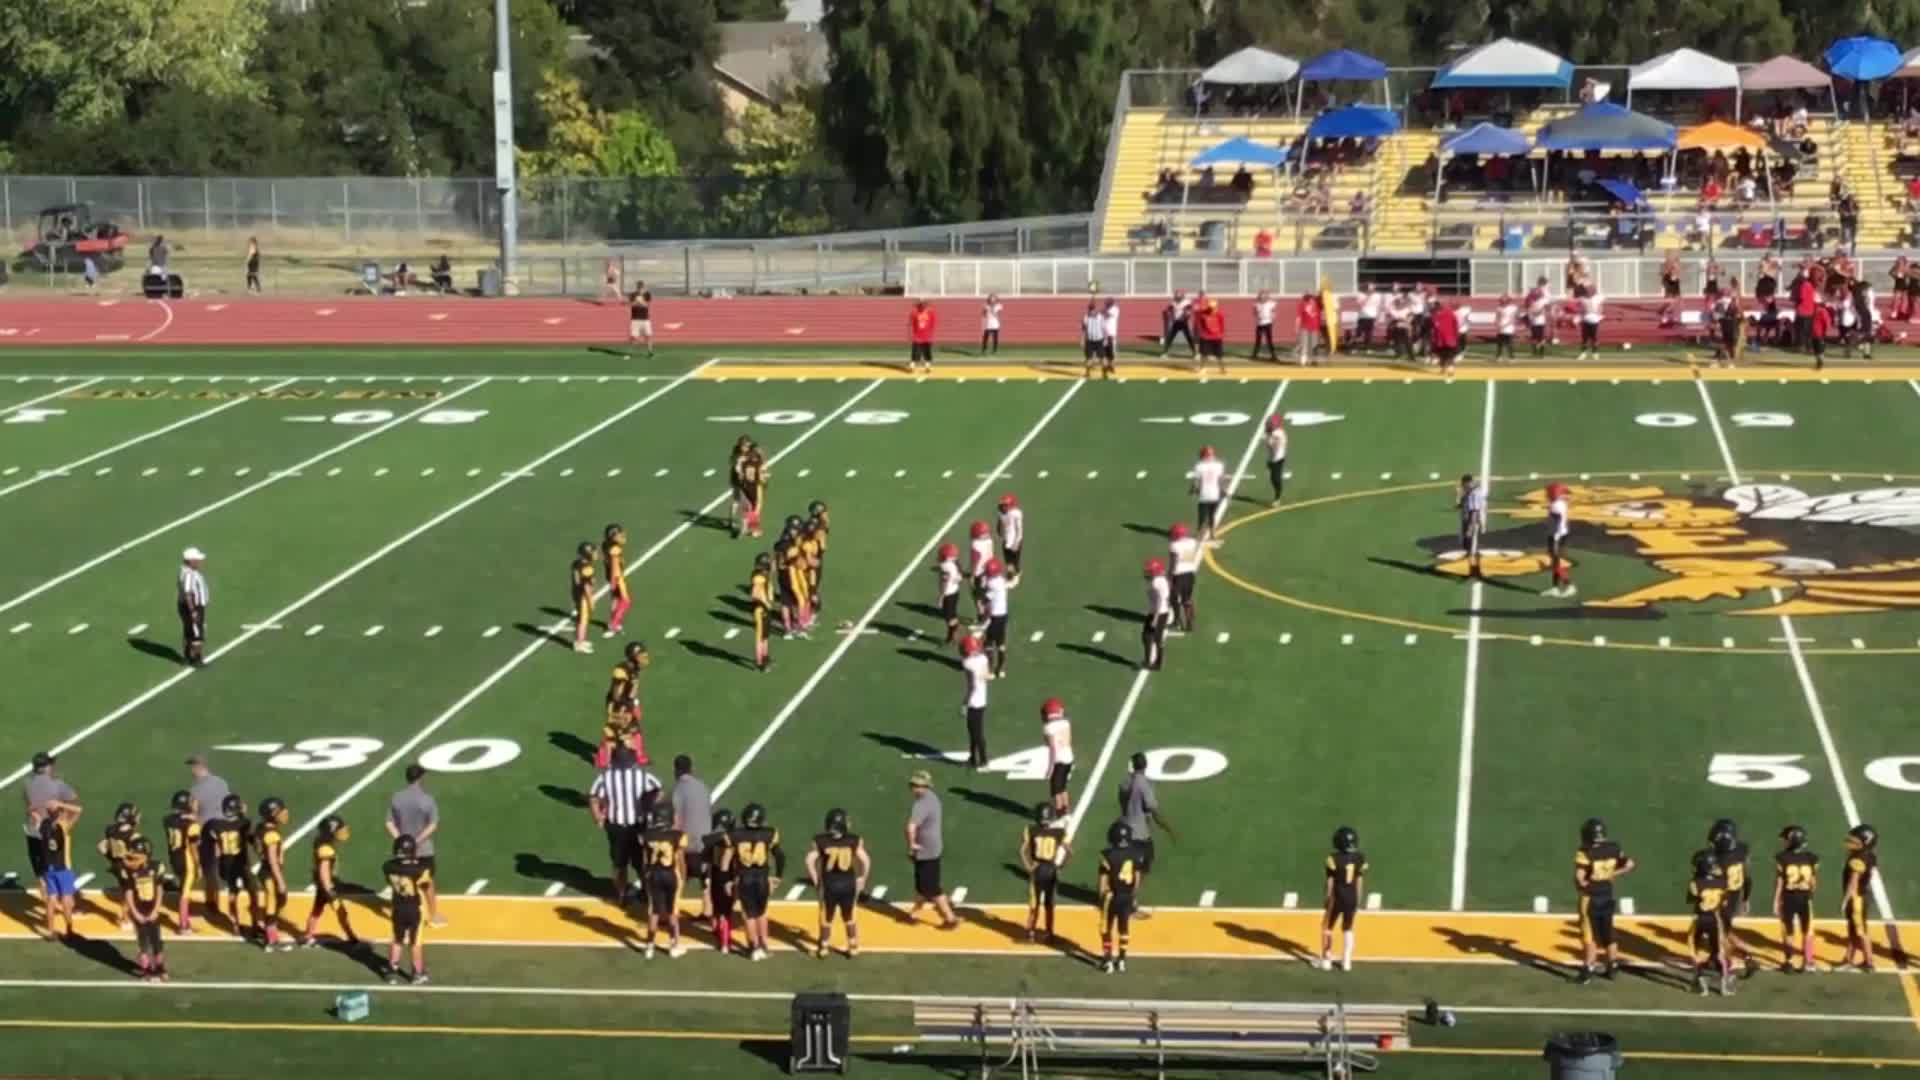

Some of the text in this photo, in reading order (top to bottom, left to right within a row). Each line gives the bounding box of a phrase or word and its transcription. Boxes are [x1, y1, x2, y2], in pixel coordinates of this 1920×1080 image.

[267, 736, 521, 772] 30
[977, 745, 1229, 781] 40
[1118, 859, 1134, 885] 4
[1345, 863, 1355, 884] 1
